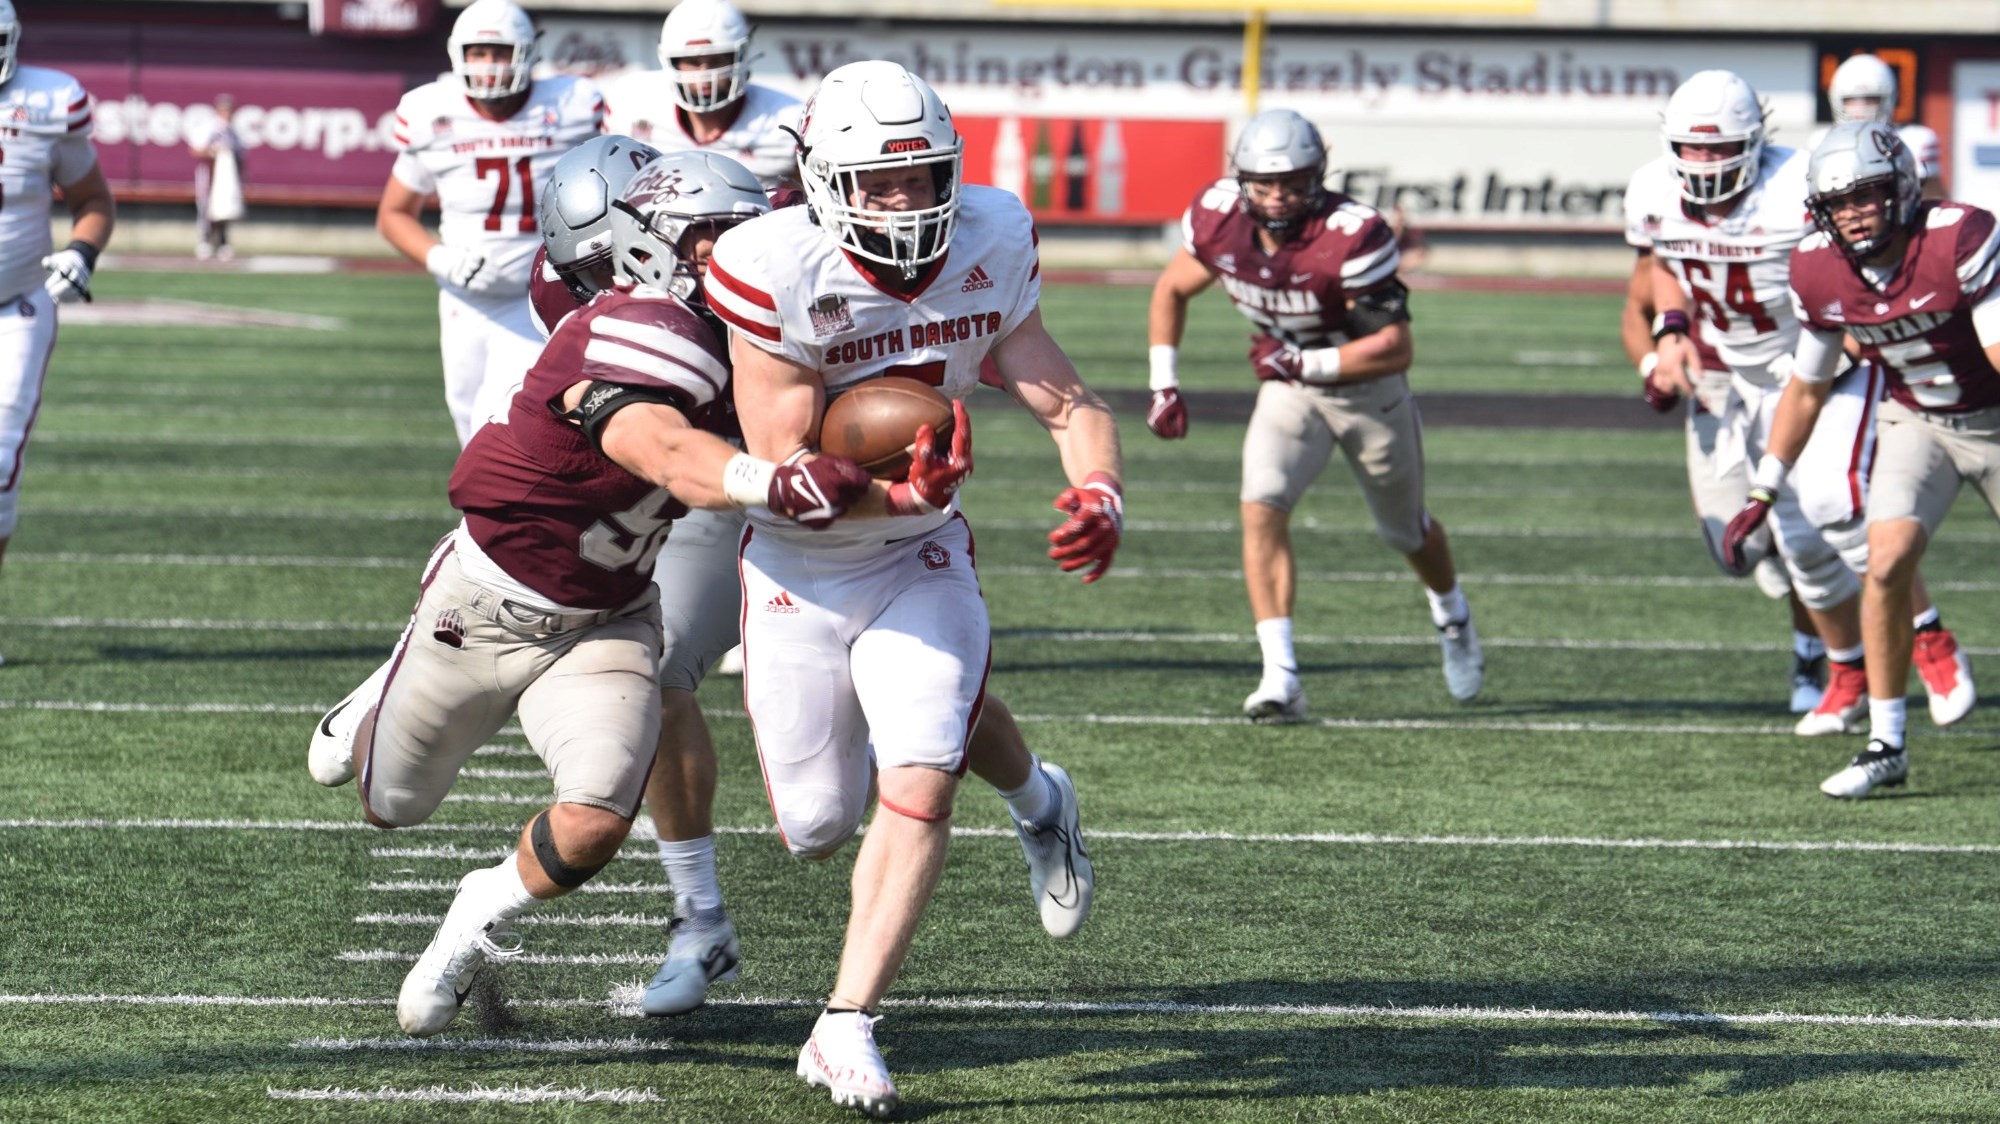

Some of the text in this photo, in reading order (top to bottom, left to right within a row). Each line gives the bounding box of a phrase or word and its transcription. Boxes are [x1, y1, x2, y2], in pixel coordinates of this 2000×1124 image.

[1414, 50, 1680, 96] Stadium
[887, 140, 927, 153] YOTES
[475, 156, 537, 232] 71
[1343, 169, 1464, 213] First
[961, 280, 994, 293] adidas
[1682, 258, 1778, 335] 64
[825, 328, 905, 365] SOUTH
[909, 311, 1002, 349] DAKOTA
[1878, 338, 1962, 407] 5
